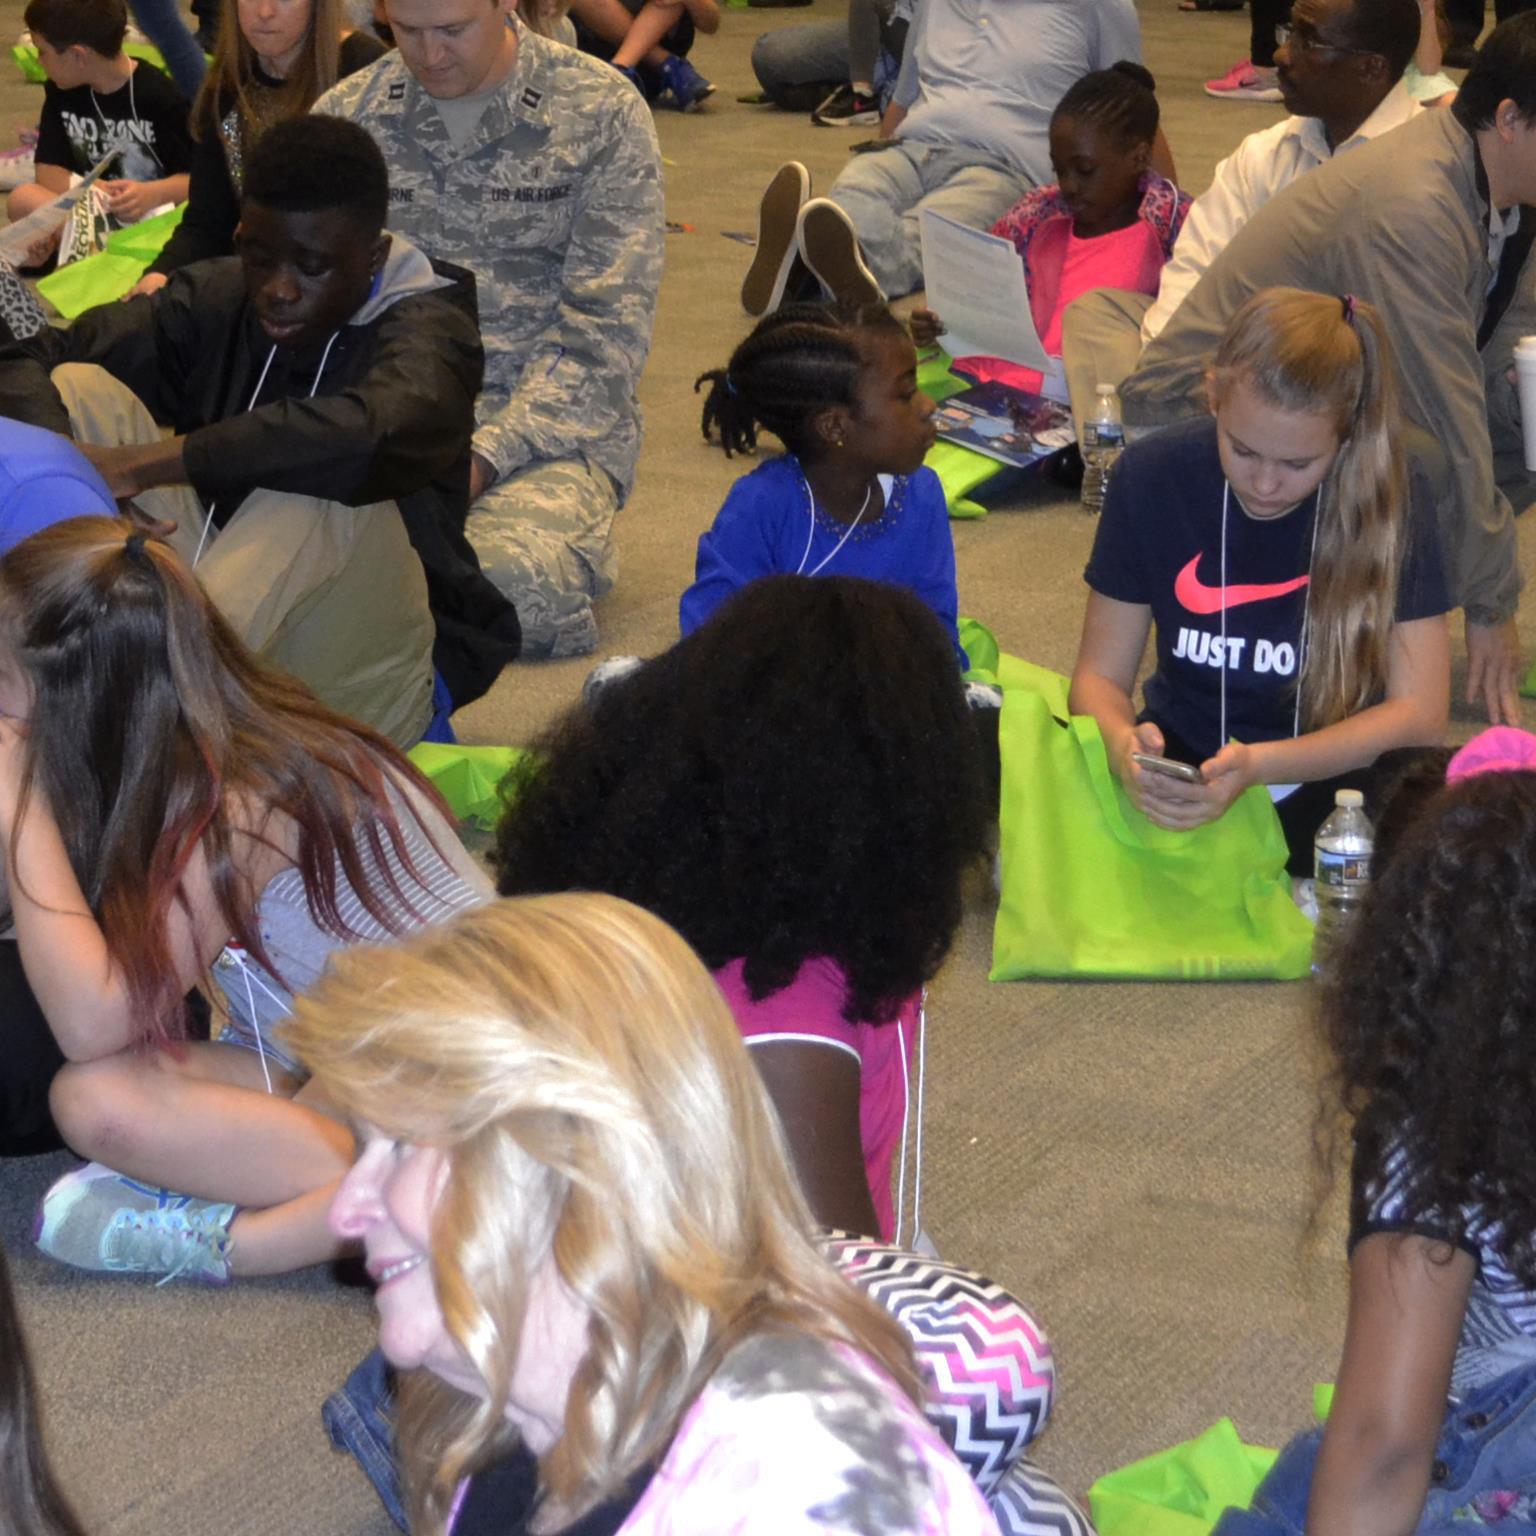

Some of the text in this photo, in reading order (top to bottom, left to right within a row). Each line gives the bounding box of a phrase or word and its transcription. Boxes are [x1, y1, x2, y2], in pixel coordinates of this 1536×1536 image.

[388, 187, 415, 203] RNE
[491, 183, 573, 203] US AIR FORCE
[1172, 626, 1296, 676] JUST DO
